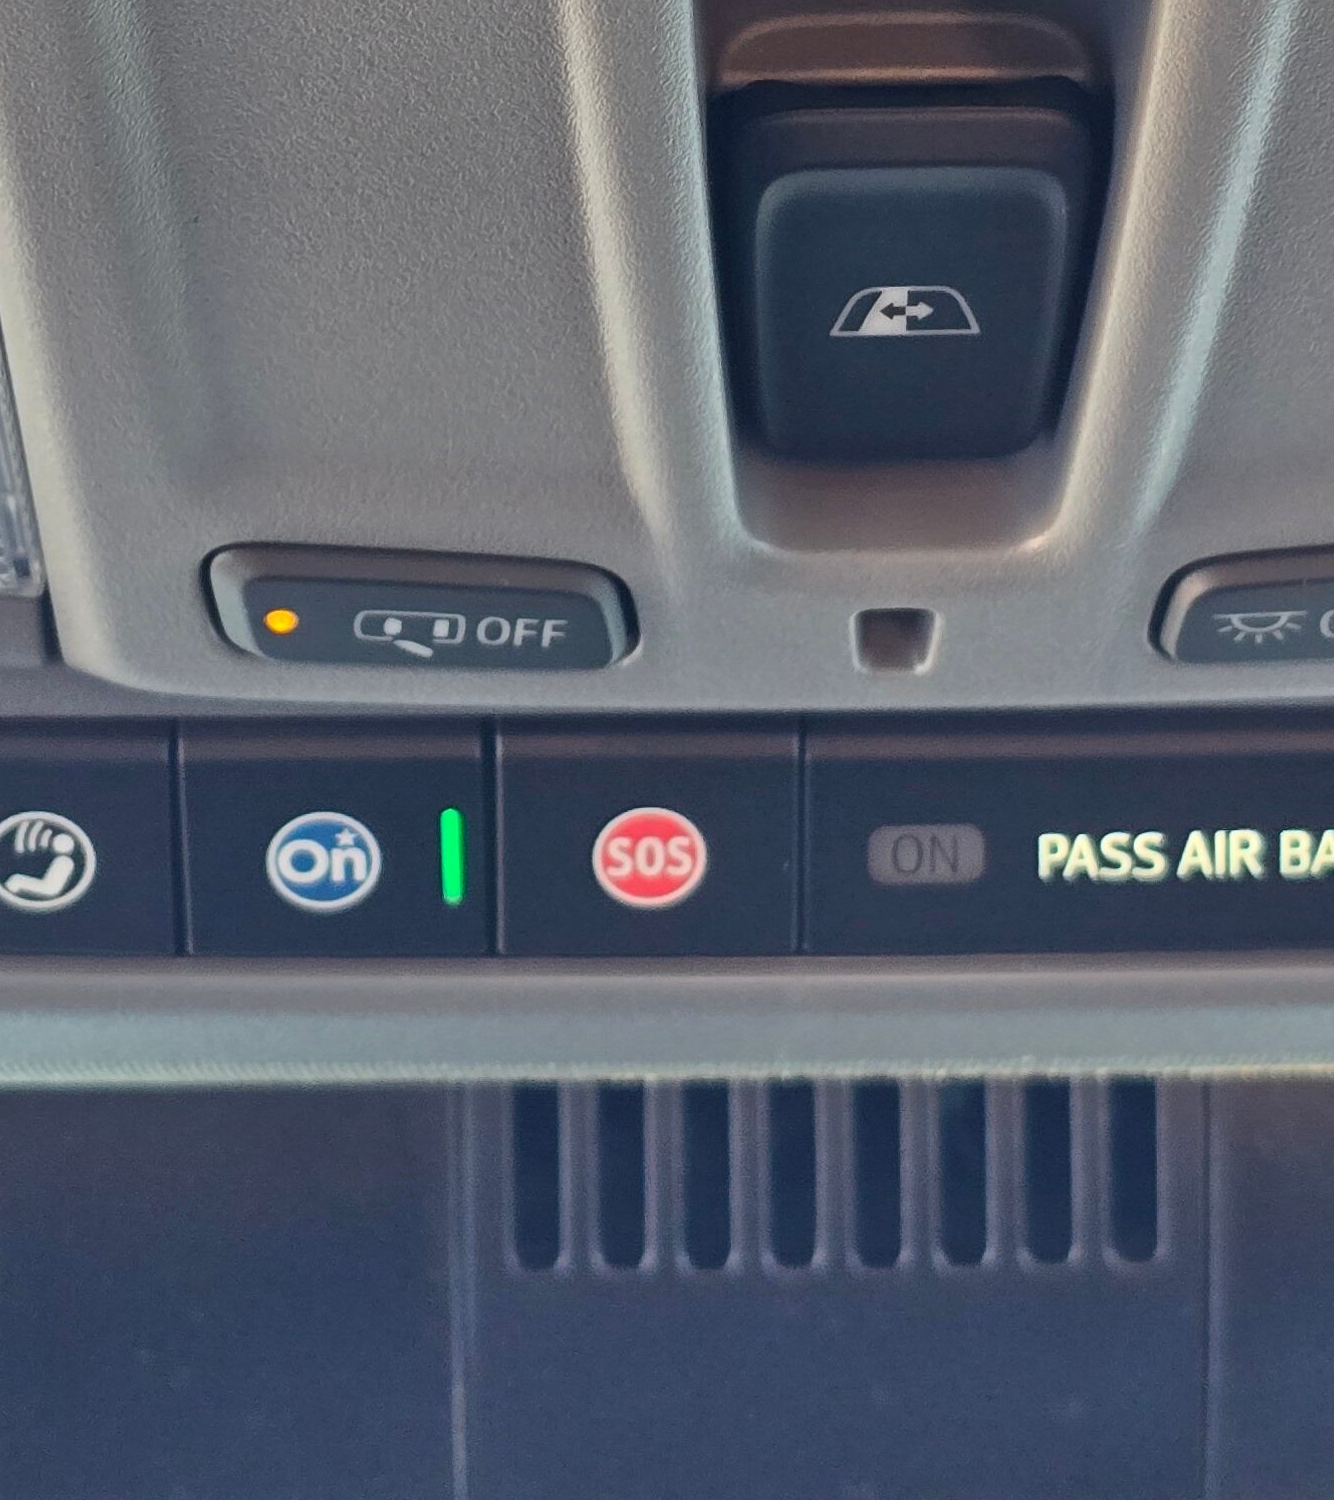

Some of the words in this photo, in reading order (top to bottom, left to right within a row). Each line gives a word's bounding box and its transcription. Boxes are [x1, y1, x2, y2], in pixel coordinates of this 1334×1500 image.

[475, 617, 569, 648] OFF
[606, 834, 692, 878] SOS
[891, 833, 959, 876] ON
[1037, 831, 1164, 882] PASS
[1177, 831, 1263, 880] AIR
